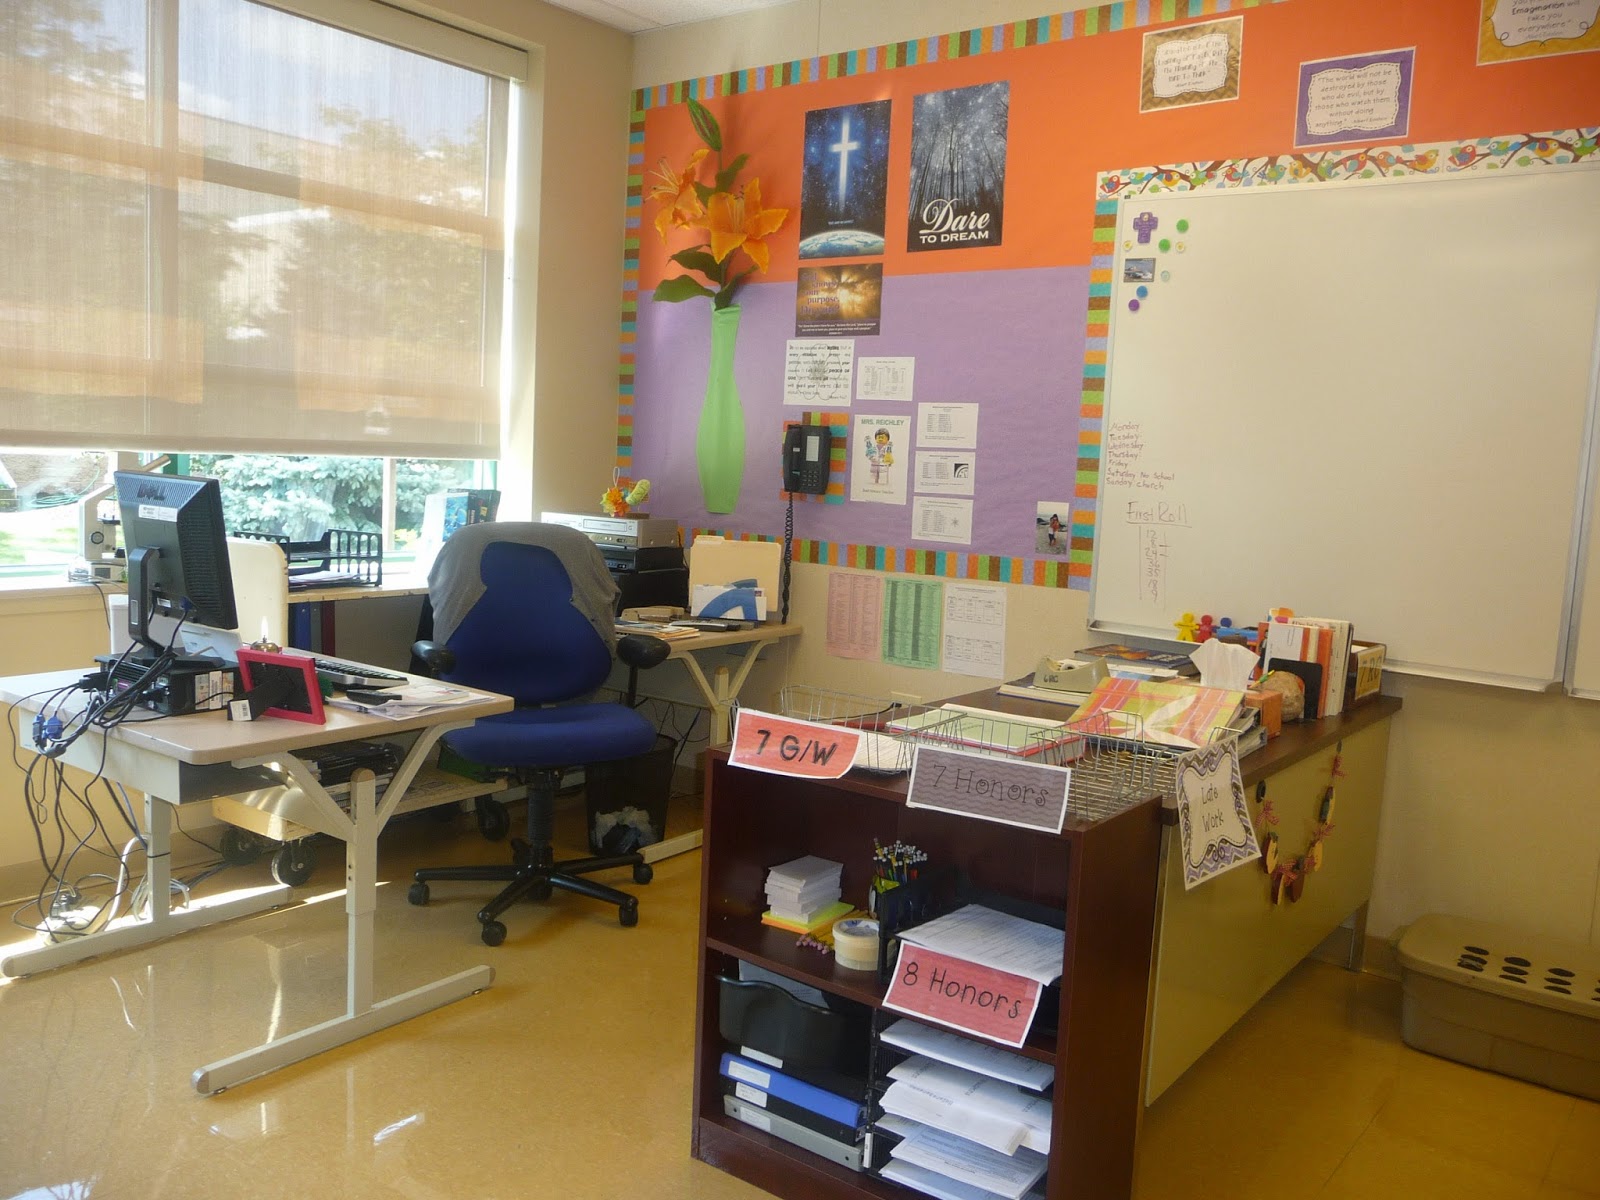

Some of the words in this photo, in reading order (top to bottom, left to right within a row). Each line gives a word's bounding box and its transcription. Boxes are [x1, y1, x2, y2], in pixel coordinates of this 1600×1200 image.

[1512, 3, 1564, 15] Imagination
[1547, 12, 1562, 21] you
[1336, 73, 1355, 81] world
[1321, 83, 1355, 92] destroyed
[1357, 81, 1365, 89] by
[1376, 88, 1385, 96] by
[1351, 98, 1371, 106] watch
[1373, 96, 1391, 104] them
[1329, 109, 1353, 117] without
[1355, 107, 1374, 115] doing
[919, 198, 990, 234] Dare
[919, 235, 937, 244] TO
[941, 230, 989, 243] DREAM
[1109, 421, 1140, 432] Monday
[1109, 459, 1128, 469] Friday
[1107, 467, 1136, 479] Saturday
[1153, 472, 1175, 481] School
[1106, 477, 1133, 488] Sunday
[137, 482, 166, 501] DELL
[1126, 501, 1153, 521] First
[1158, 501, 1188, 524] Roll
[1146, 529, 1157, 539] 12
[757, 729, 771, 755] 7
[780, 734, 838, 766] G/W
[932, 764, 947, 787] 7
[954, 768, 1049, 807] Honors
[1201, 783, 1219, 805] Late
[1202, 809, 1224, 832] Work
[903, 961, 919, 986] 8
[929, 967, 1022, 1019] Honors
